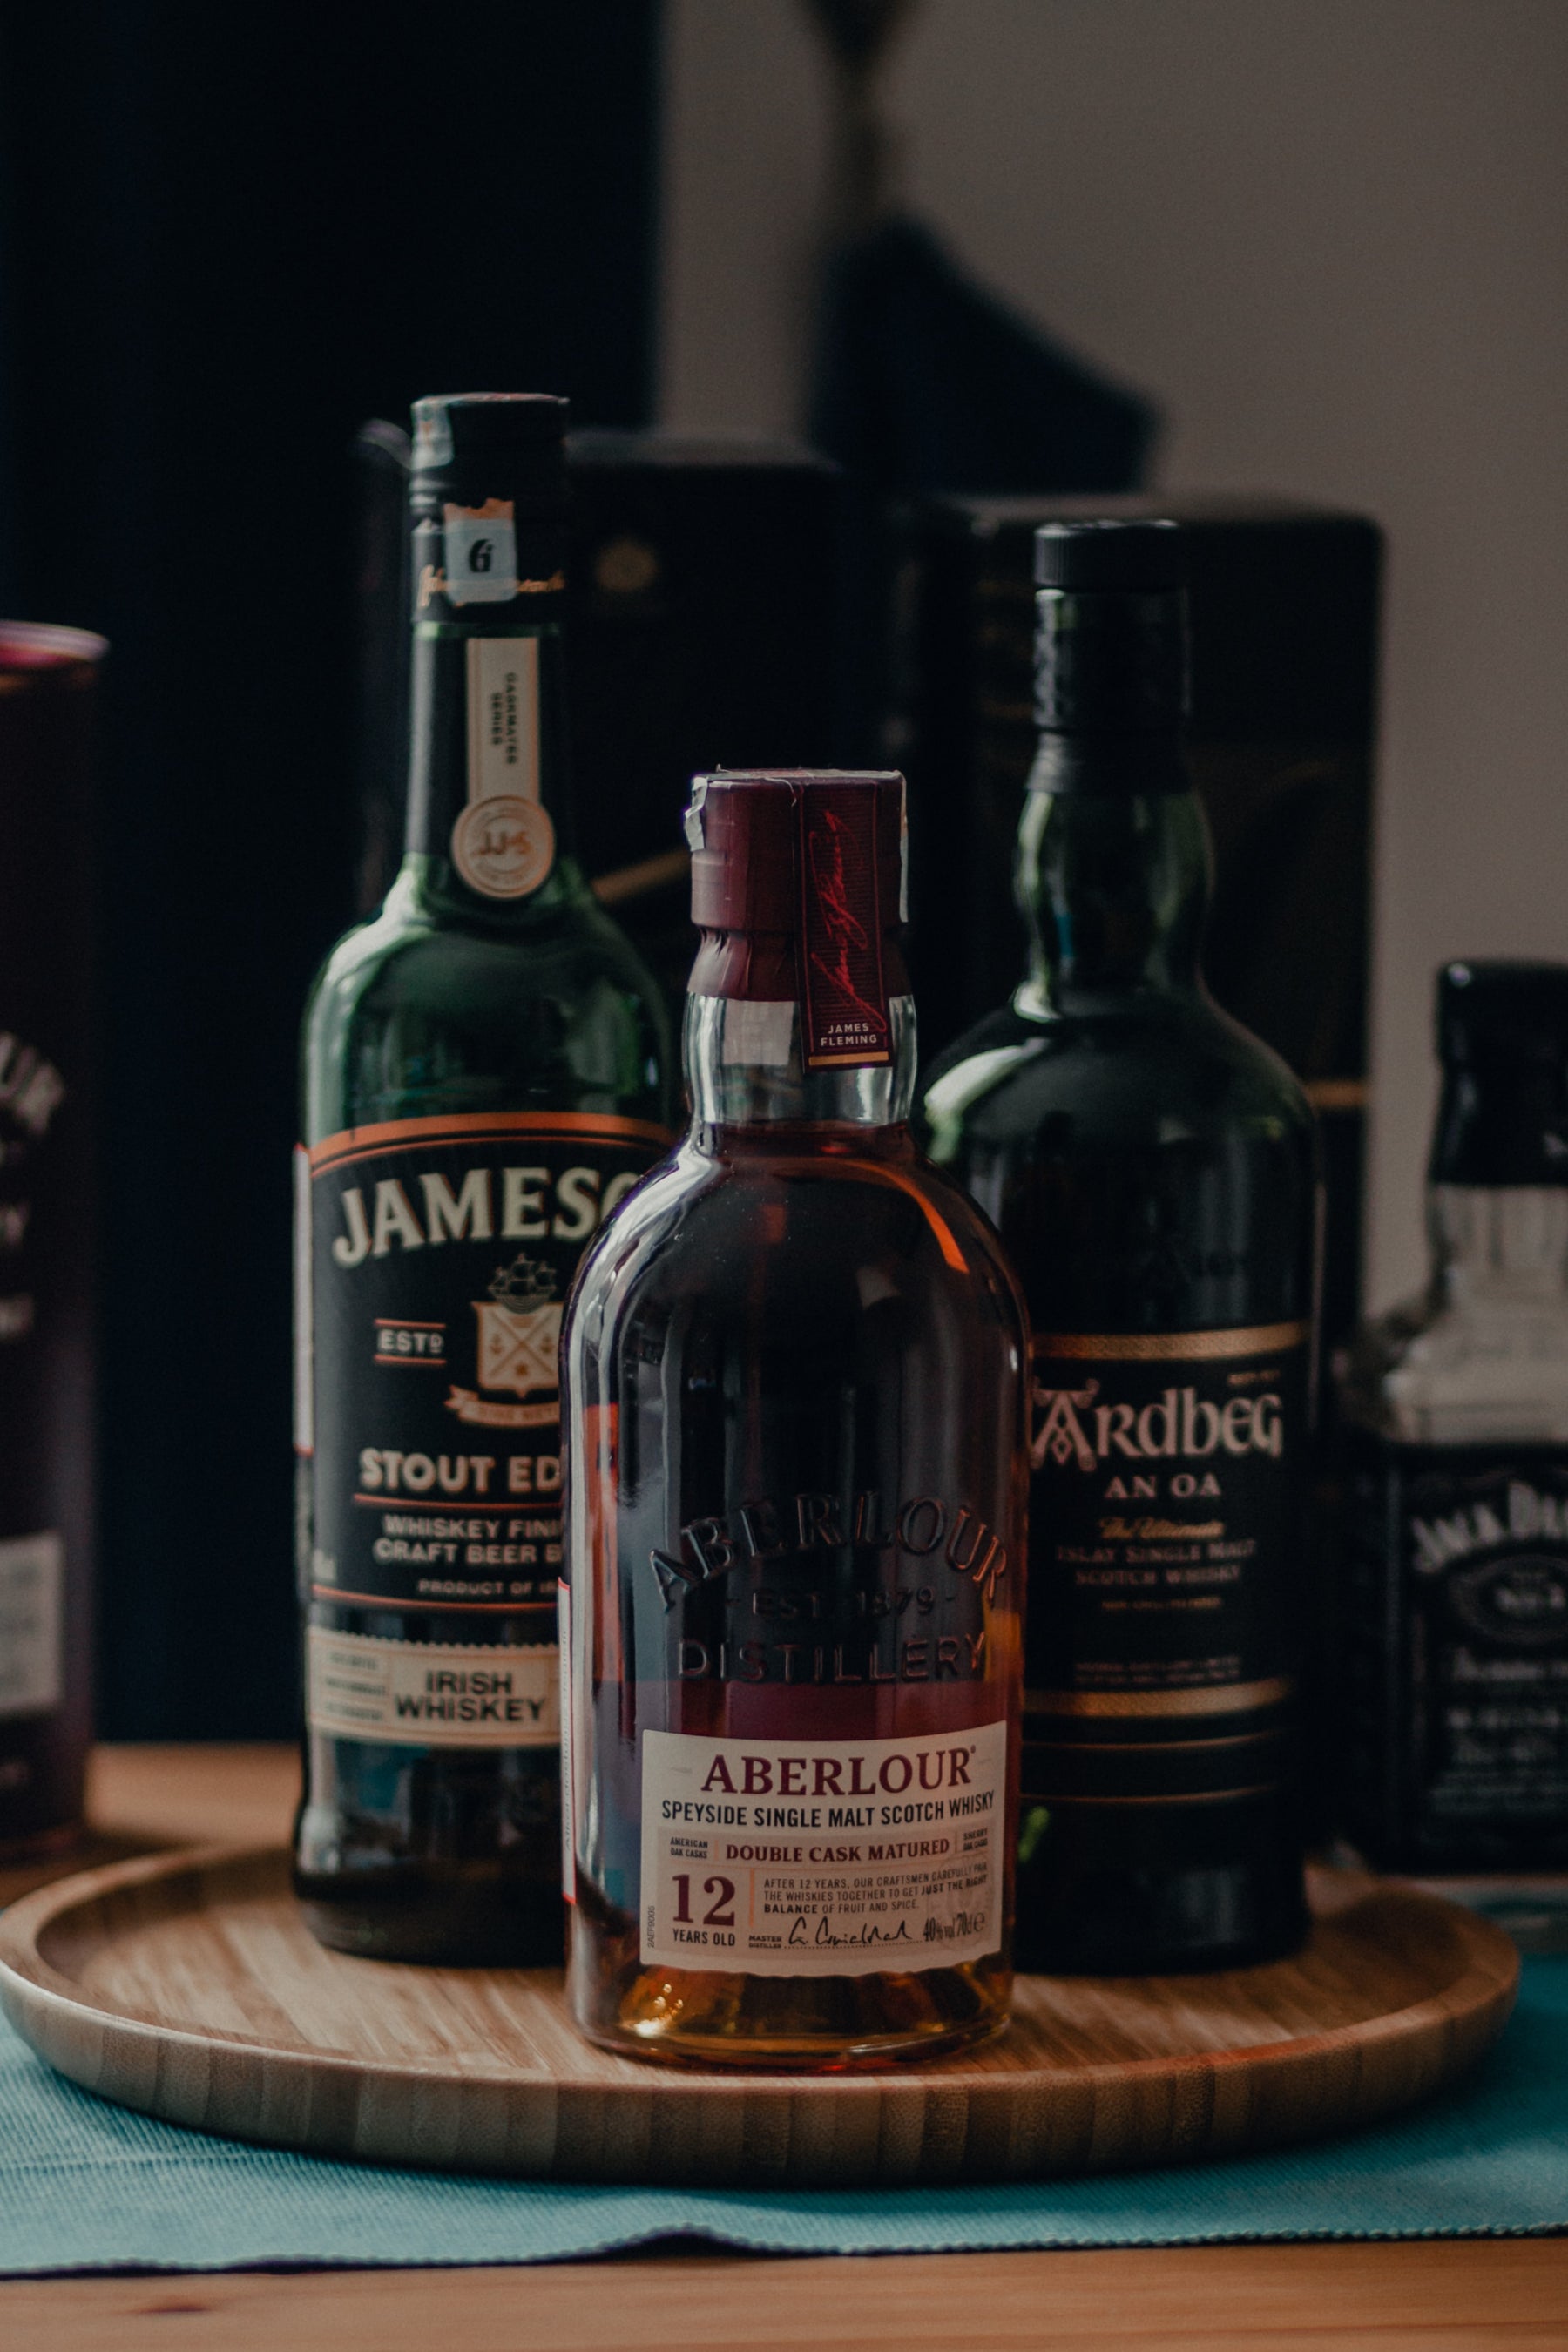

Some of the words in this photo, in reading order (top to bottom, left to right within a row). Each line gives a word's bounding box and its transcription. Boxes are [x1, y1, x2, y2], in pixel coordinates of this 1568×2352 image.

[469, 538, 493, 573] 6
[821, 1034, 877, 1047] FLEMING
[828, 1022, 869, 1034] JAMES
[359, 1446, 497, 1494] STOUT
[1103, 1474, 1158, 1499] AN
[1168, 1471, 1222, 1499] OA
[382, 1513, 502, 1539] WHISKEY
[374, 1538, 459, 1564] CRAFT
[464, 1542, 537, 1565] BEER
[648, 1490, 1008, 1615] ABERLOUR
[677, 1631, 986, 1683] DISTILLERY
[426, 1670, 512, 1695] IRISH
[395, 1695, 545, 1722] WHISKEY
[700, 1747, 972, 1796] ABERLOUR
[661, 1800, 747, 1826] SPEYSIDE
[754, 1808, 821, 1828] SINGLE
[828, 1807, 875, 1828] MALT
[881, 1801, 944, 1825] SCOTCH
[950, 1789, 995, 1817] WHISKY
[670, 1837, 708, 1848] AMERICAN
[670, 1848, 684, 1856] OAK
[685, 1848, 708, 1859] CASKS
[726, 1844, 803, 1862] DOUBLE
[809, 1845, 861, 1862] CASK
[868, 1838, 950, 1861] MATURED
[764, 1878, 794, 1889] AFTER
[799, 1878, 811, 1889] 12
[814, 1878, 850, 1889] YEARS,
[854, 1877, 874, 1888] OUR
[876, 1870, 929, 1887] CRAFTSMEN
[764, 1891, 783, 1901] THE
[786, 1891, 834, 1902] WHISKIES
[836, 1889, 886, 1901] TOGETHER
[889, 1888, 900, 1898] TO
[902, 1886, 918, 1897] GET
[921, 1882, 943, 1896] JUST
[947, 1879, 963, 1891] THE
[965, 1874, 988, 1888] RIGHT
[672, 1874, 735, 1927] 12
[764, 1903, 818, 1914] BALANCE
[822, 1903, 835, 1914] OF
[838, 1903, 865, 1914] FRUIT
[869, 1901, 889, 1912] AND
[891, 1899, 919, 1910] SPICE.
[672, 1928, 708, 1944] YEARS
[713, 1932, 736, 1947] OLD
